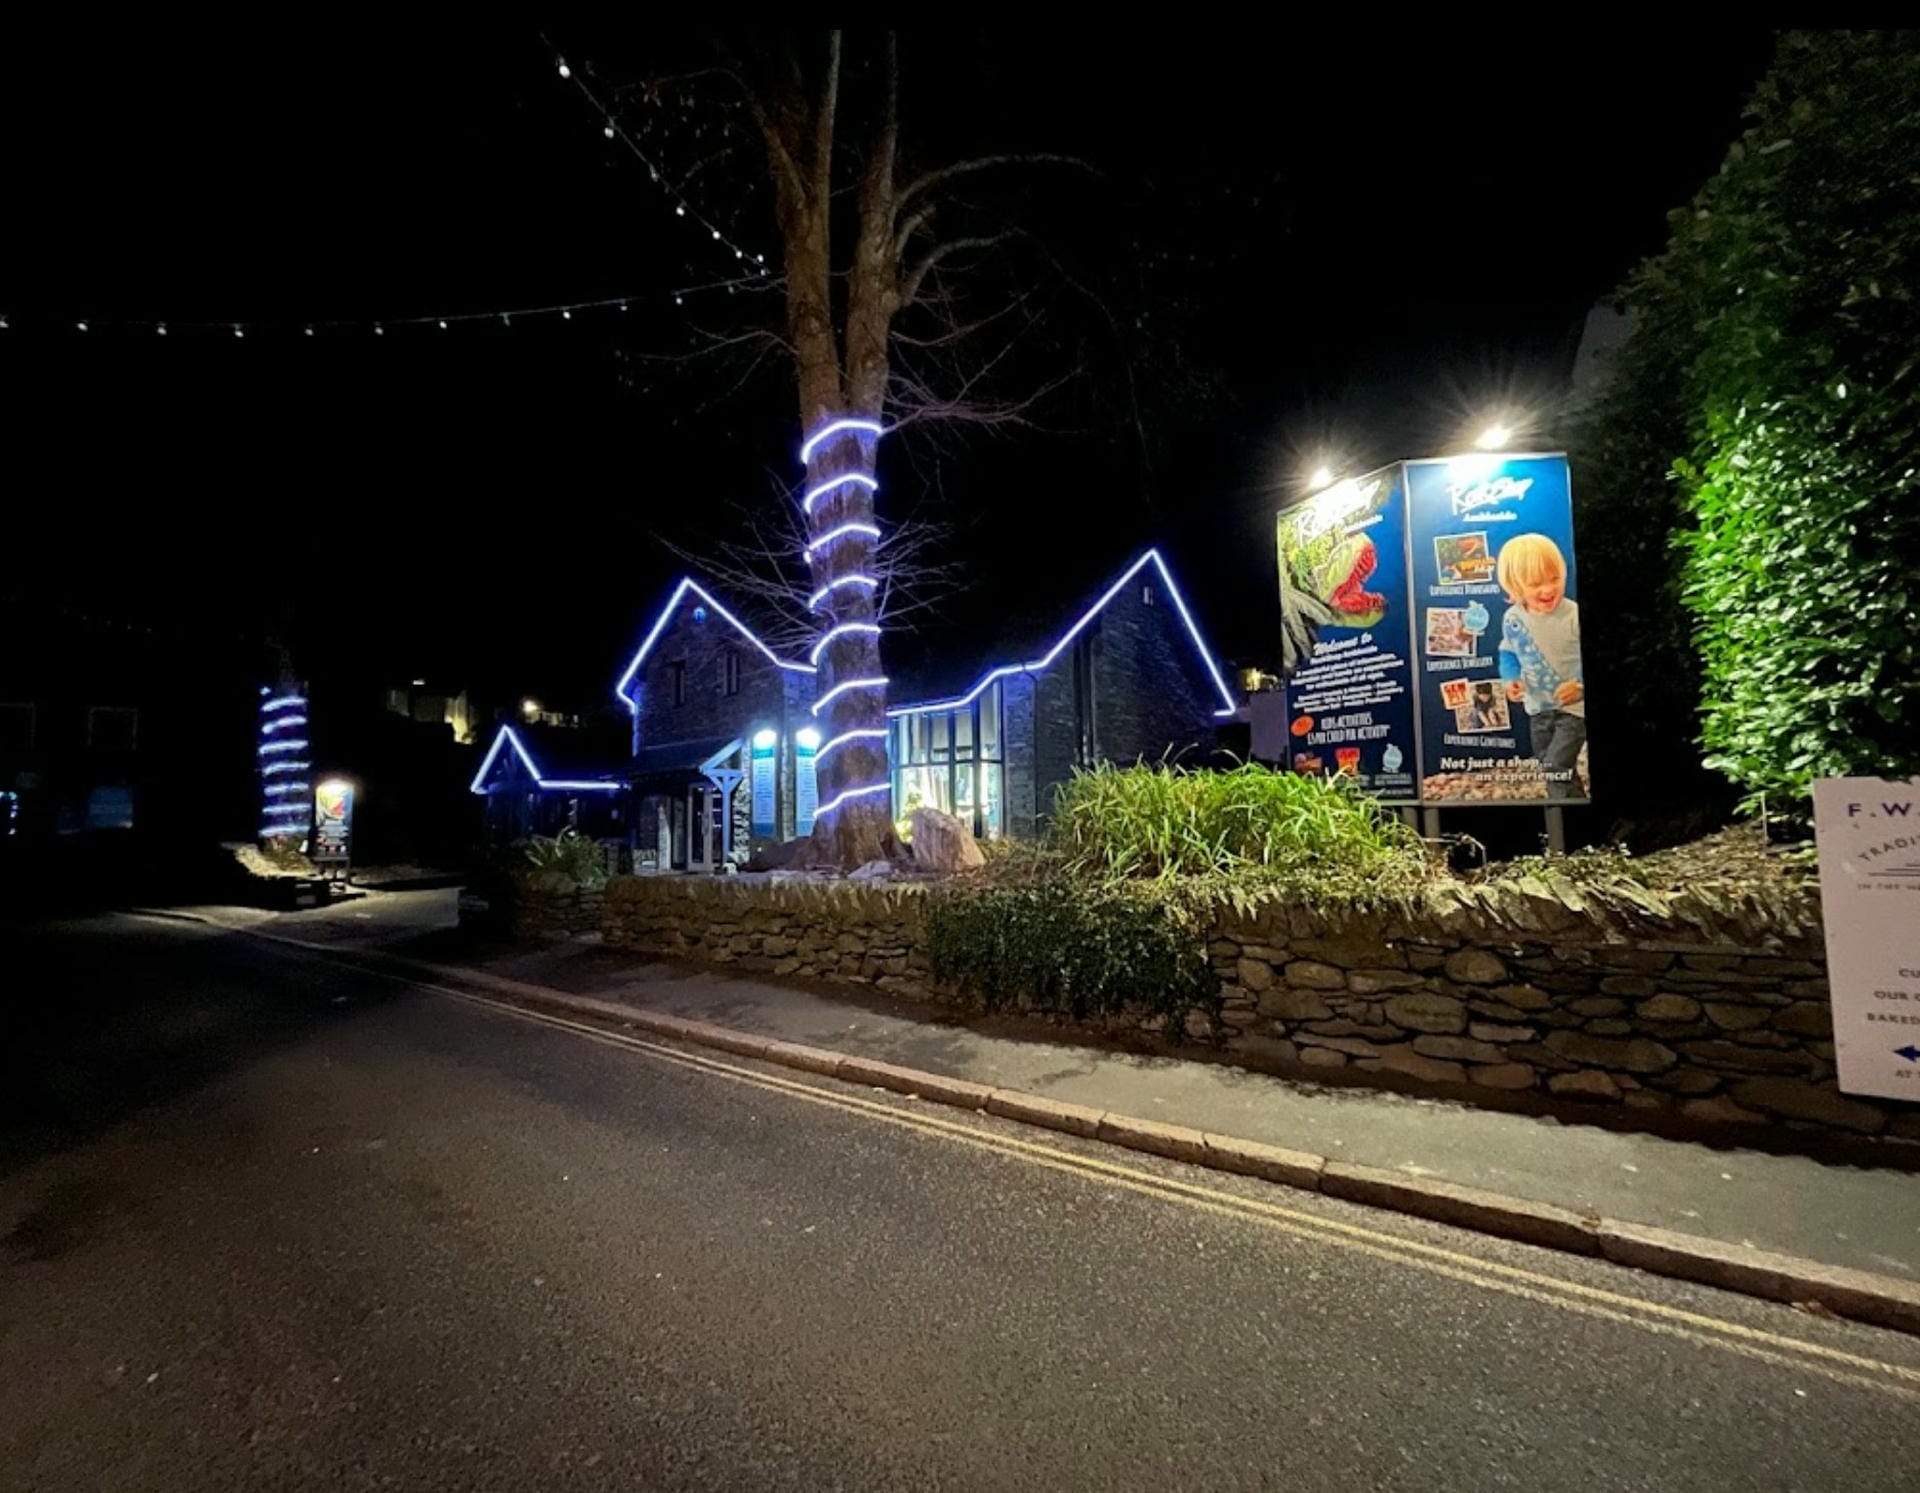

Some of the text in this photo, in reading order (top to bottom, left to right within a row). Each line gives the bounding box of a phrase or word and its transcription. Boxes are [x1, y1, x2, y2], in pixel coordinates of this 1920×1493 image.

[1440, 757, 1466, 770] Not
[1467, 756, 1494, 771] just
[1496, 758, 1505, 768] a
[1475, 769, 1574, 785] an experience!
[1873, 990, 1909, 1000] OUR
